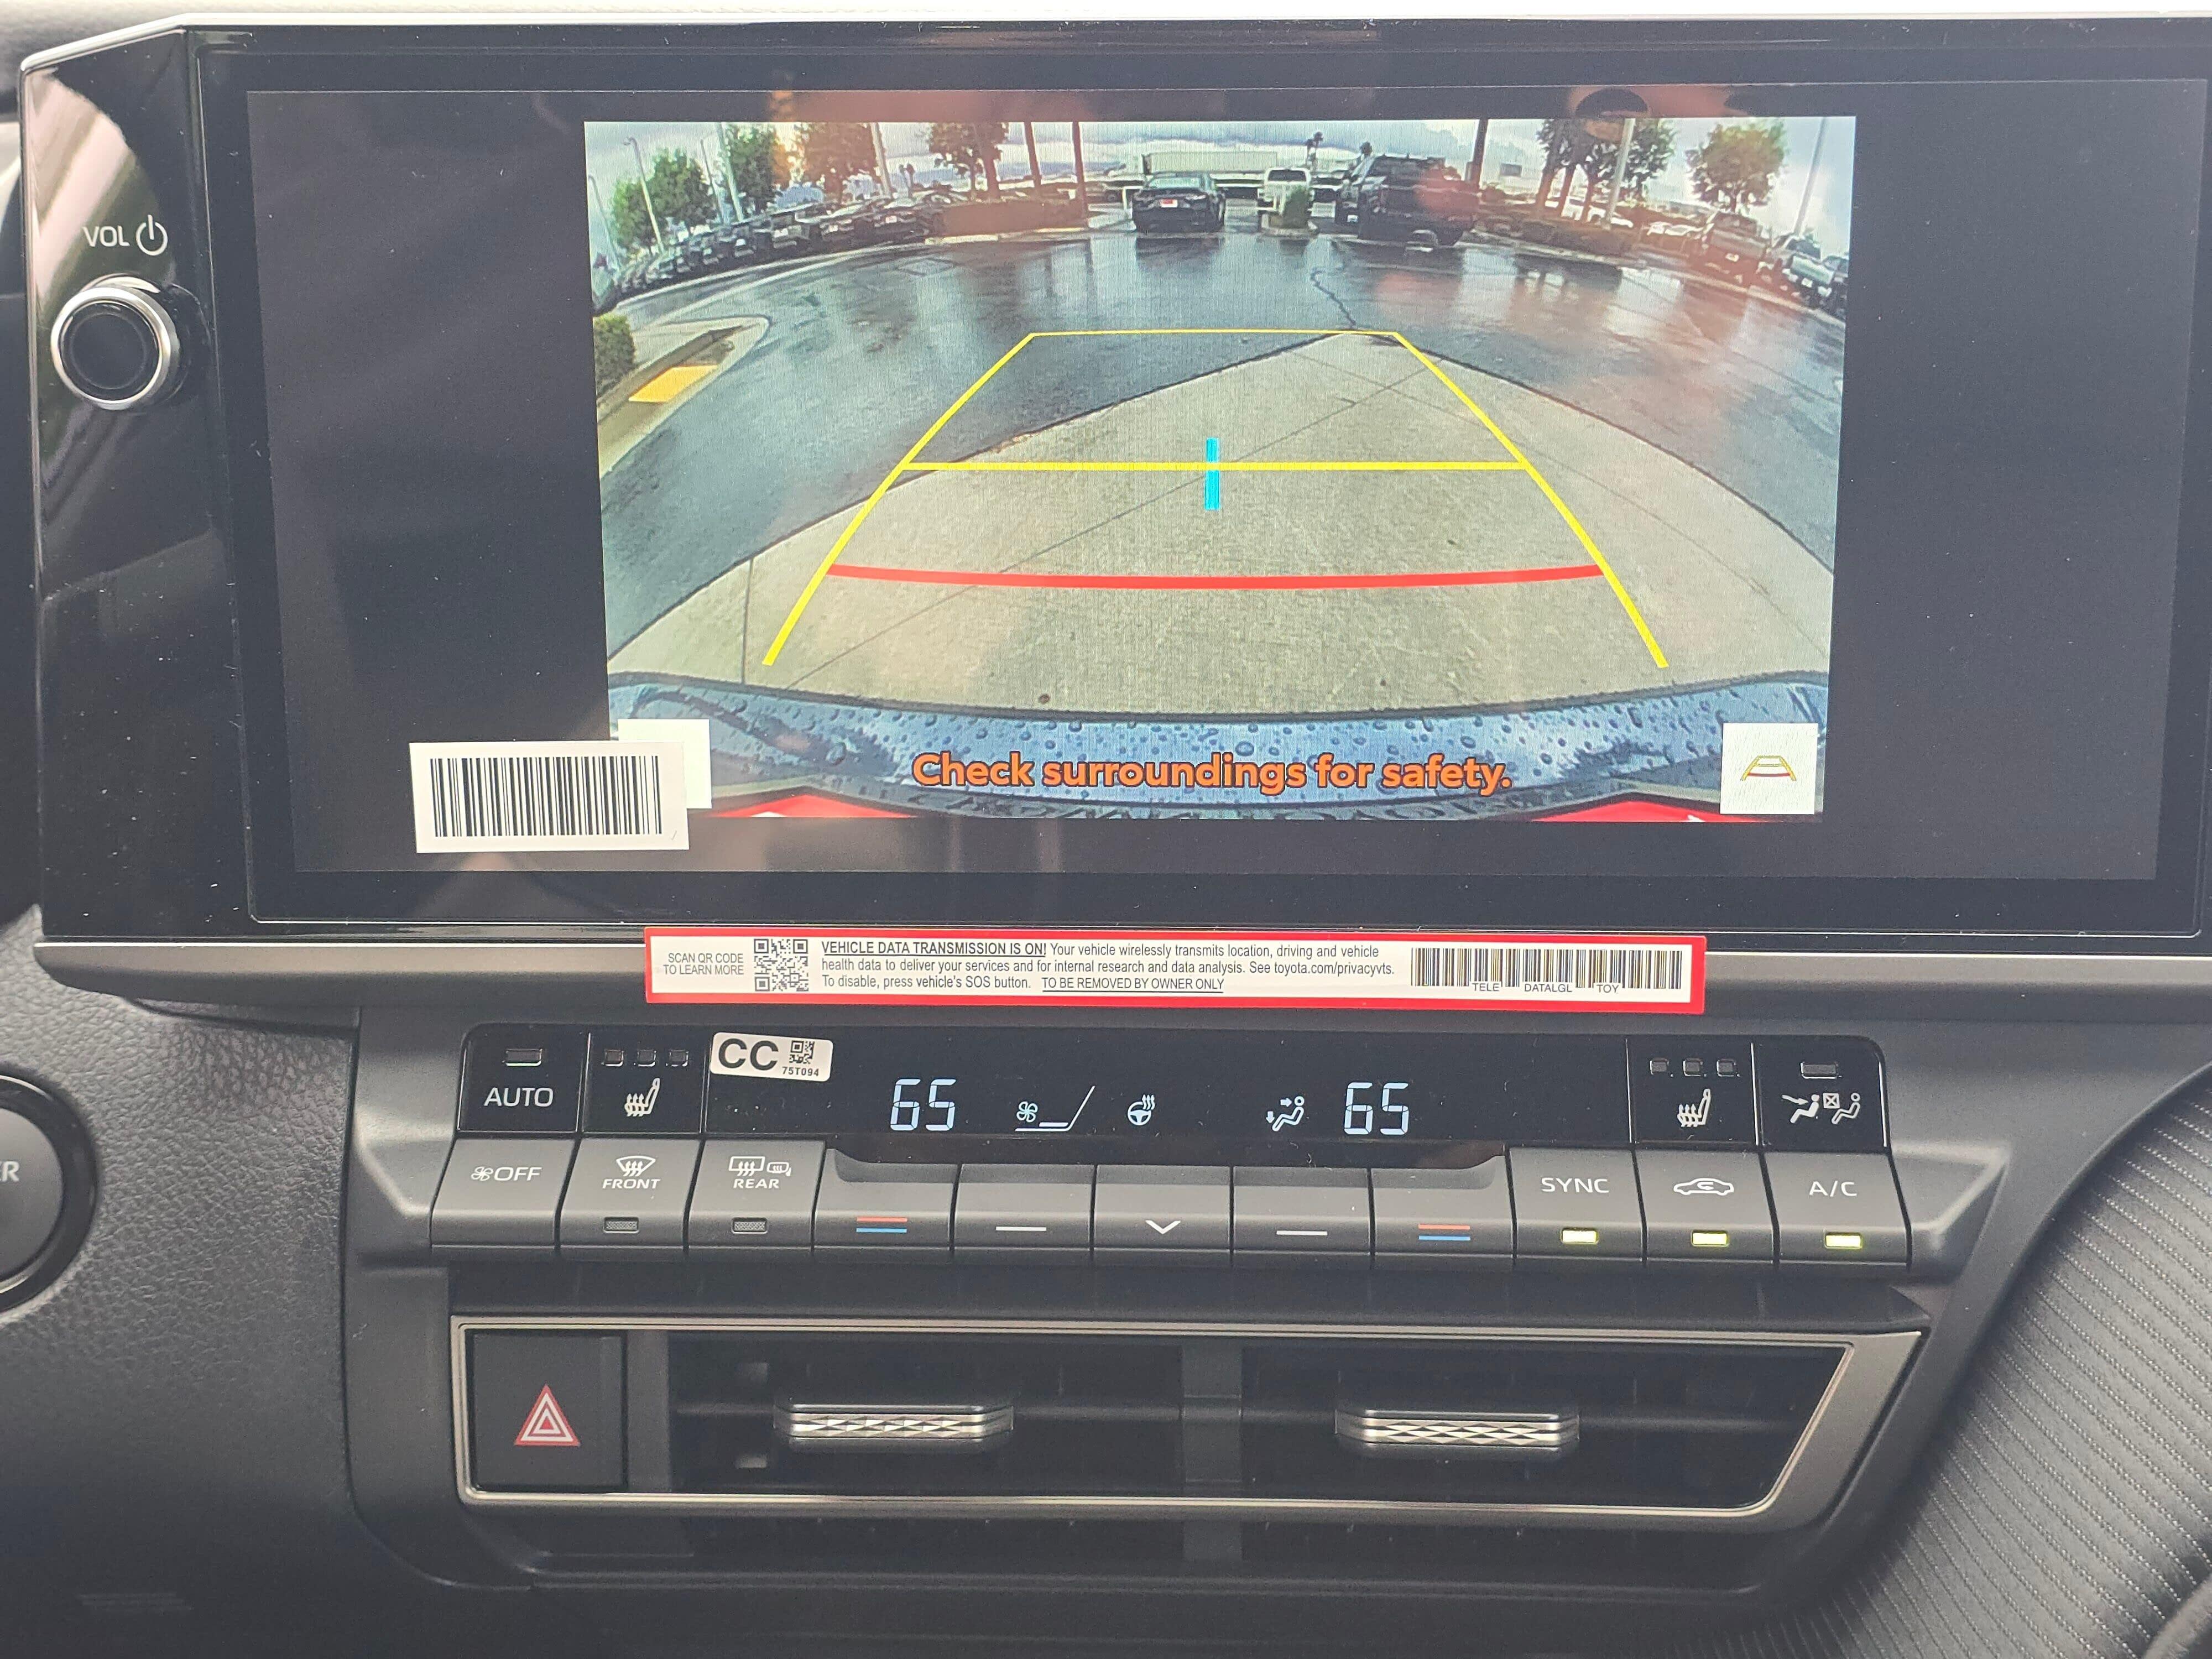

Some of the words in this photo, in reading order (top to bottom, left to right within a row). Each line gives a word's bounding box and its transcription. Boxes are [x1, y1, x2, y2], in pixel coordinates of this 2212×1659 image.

[82, 225, 131, 247] VOL
[912, 750, 1035, 786] Check
[1042, 752, 1306, 796] surroundings
[1314, 752, 1375, 789] for
[1382, 753, 1512, 797] safety.
[668, 953, 695, 963] SCAN
[698, 953, 713, 963] QR
[716, 953, 744, 963] CODE
[822, 941, 874, 953] VEHICLE
[878, 942, 910, 954] DATA
[913, 942, 1006, 955] TRANSMISSION
[1010, 942, 1021, 955] IS
[1025, 942, 1046, 956] ON!
[1051, 943, 1074, 956] Your
[1078, 943, 1115, 956] vehicle
[1119, 943, 1171, 959] wirelessly
[1175, 944, 1224, 957] transmits
[1228, 944, 1273, 958] location,
[1277, 945, 1312, 959] driving
[1317, 945, 1337, 957] and
[1341, 945, 1379, 957] vehicle
[663, 964, 677, 974] TO
[680, 964, 712, 975] LEARN
[715, 965, 744, 975] MORE
[822, 958, 854, 971] health
[858, 958, 881, 971] data
[886, 959, 895, 971] to
[900, 958, 935, 971] deliver
[938, 961, 962, 974] your
[966, 960, 1010, 972] services
[1013, 959, 1033, 972] and
[1037, 959, 1051, 972] for
[1055, 959, 1094, 972] internal
[1098, 960, 1144, 973] research
[1148, 961, 1167, 973] and
[1171, 961, 1194, 973] data
[1198, 961, 1245, 976] analysis.
[1249, 961, 1270, 973] See
[1274, 961, 1395, 977] toyota.com/privacyvts.
[822, 974, 834, 987] To
[838, 974, 880, 989] disable,
[884, 978, 912, 990] press
[916, 975, 962, 988] vehicle's
[966, 975, 990, 988] SOS
[995, 976, 1031, 988] button.
[1042, 977, 1056, 988] TO
[1060, 977, 1074, 988] BE
[1077, 977, 1131, 989] REMOVED
[1135, 978, 1149, 989] BY
[1151, 978, 1192, 989] OWNER
[1196, 978, 1224, 990] ONLY
[1472, 983, 1499, 993] TELE
[1525, 983, 1573, 993] DATALGL
[1597, 984, 1619, 994] TOY
[718, 1038, 779, 1071] CC
[782, 1066, 820, 1076] 75T094
[484, 1087, 554, 1107] AUTO
[890, 1078, 956, 1131] 65
[1344, 1082, 1409, 1136] 65
[0, 1161, 19, 1182] R
[494, 1166, 541, 1181] OFF
[602, 1178, 660, 1190] FRONT
[733, 1178, 779, 1190] REAR
[1541, 1177, 1610, 1194] SYNC
[1808, 1181, 1858, 1197] A/C
